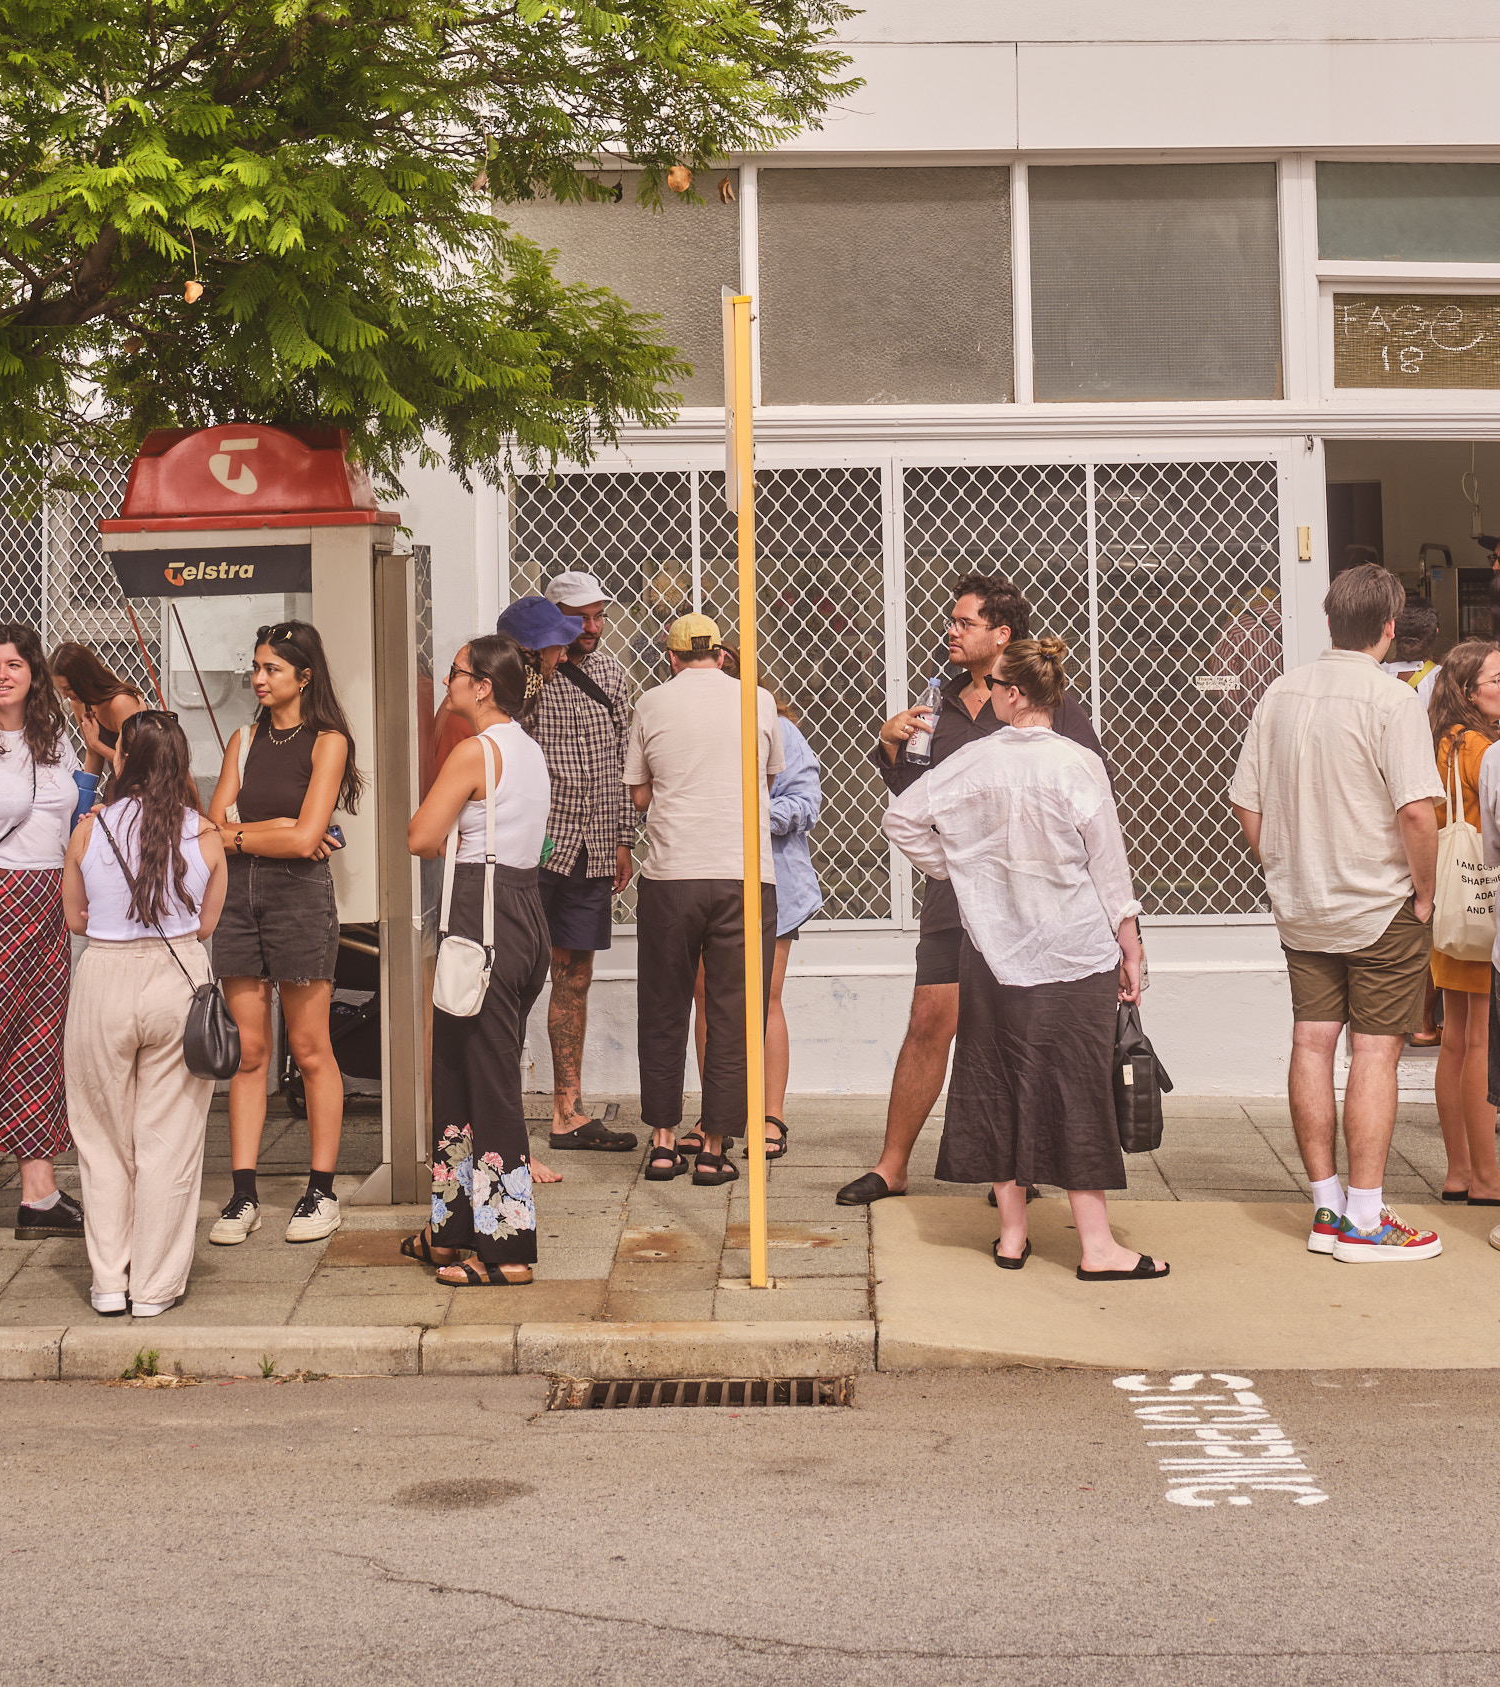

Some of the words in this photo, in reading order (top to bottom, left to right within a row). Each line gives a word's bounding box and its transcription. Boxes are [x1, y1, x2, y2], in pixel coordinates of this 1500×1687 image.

[164, 561, 254, 587] Telstra
[1456, 858, 1459, 866] I
[1461, 861, 1475, 871] AM
[1466, 905, 1486, 914] AND
[1488, 905, 1496, 914] E
[1111, 1372, 1329, 1507] STOPPING
